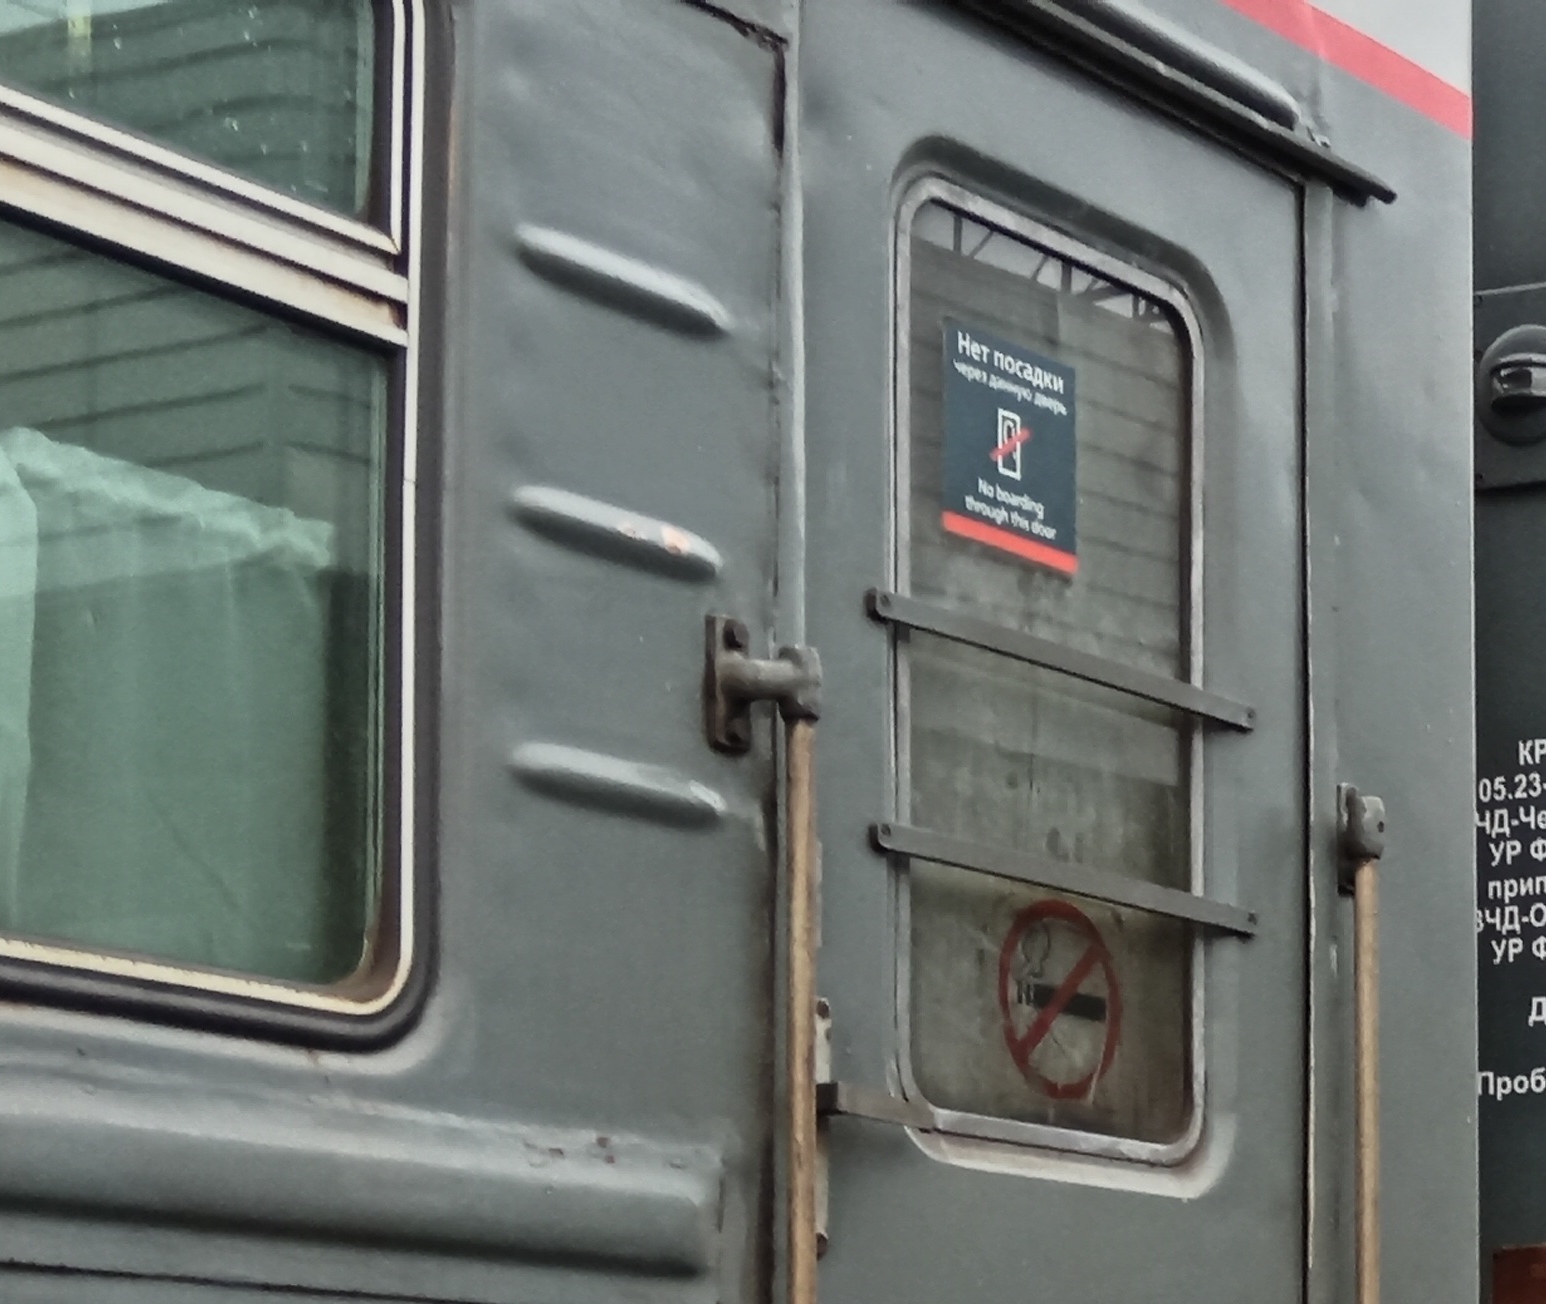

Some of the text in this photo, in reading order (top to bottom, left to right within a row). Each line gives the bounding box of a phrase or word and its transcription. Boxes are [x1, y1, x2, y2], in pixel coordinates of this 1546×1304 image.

[957, 330, 1064, 395] Нет посадки
[965, 495, 1057, 540] through this door
[978, 476, 1044, 521] No boarding
[1489, 840, 1522, 867] УР
[1491, 937, 1524, 965] УР
